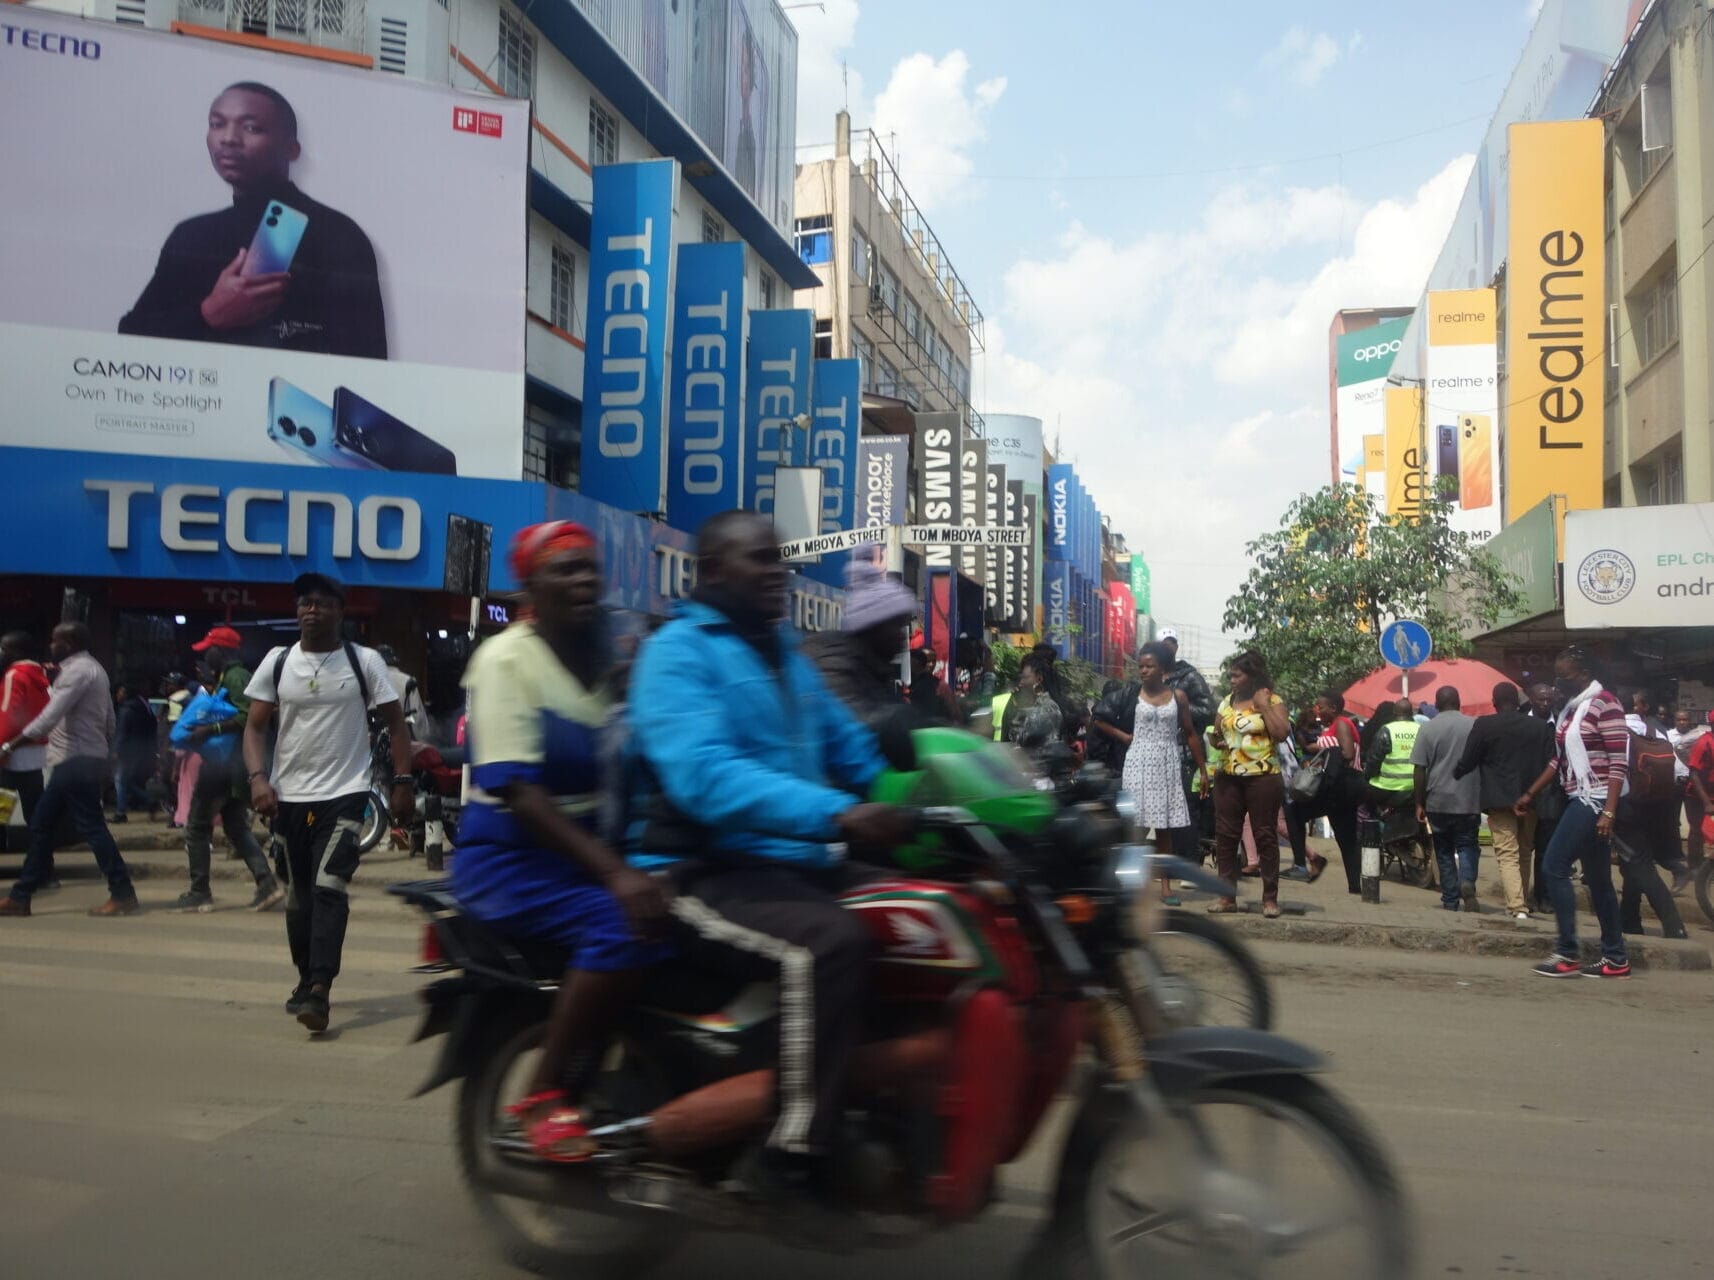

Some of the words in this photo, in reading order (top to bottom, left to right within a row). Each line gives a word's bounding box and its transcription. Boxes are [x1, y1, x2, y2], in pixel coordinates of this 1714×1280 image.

[1, 23, 101, 60] TECNO
[1437, 311, 1486, 324] realme
[599, 217, 653, 459] TECNO
[1528, 229, 1584, 450] realme
[1353, 339, 1402, 363] oppo
[73, 356, 162, 382] CAMON
[683, 290, 728, 496] TECNO
[1431, 376, 1483, 389] realme
[65, 383, 106, 401] Own
[115, 387, 145, 404] The
[152, 390, 222, 413] Spotlight
[755, 347, 797, 517] TECN
[83, 478, 422, 562] TECNO
[1054, 478, 1067, 546] NOKIA
[804, 535, 844, 554] MBOYA
[849, 528, 887, 546] STREET
[911, 528, 938, 543] TOM
[941, 528, 983, 543] MBOYA
[987, 529, 1027, 544] STREET
[1471, 530, 1492, 541] MP
[1582, 552, 1619, 577] LEICESTER
[1618, 557, 1632, 575] CITY
[1657, 554, 1688, 567] EPL
[202, 587, 256, 607] TCL
[1581, 580, 1616, 601] FOOTBALL
[487, 604, 509, 623] TCL
